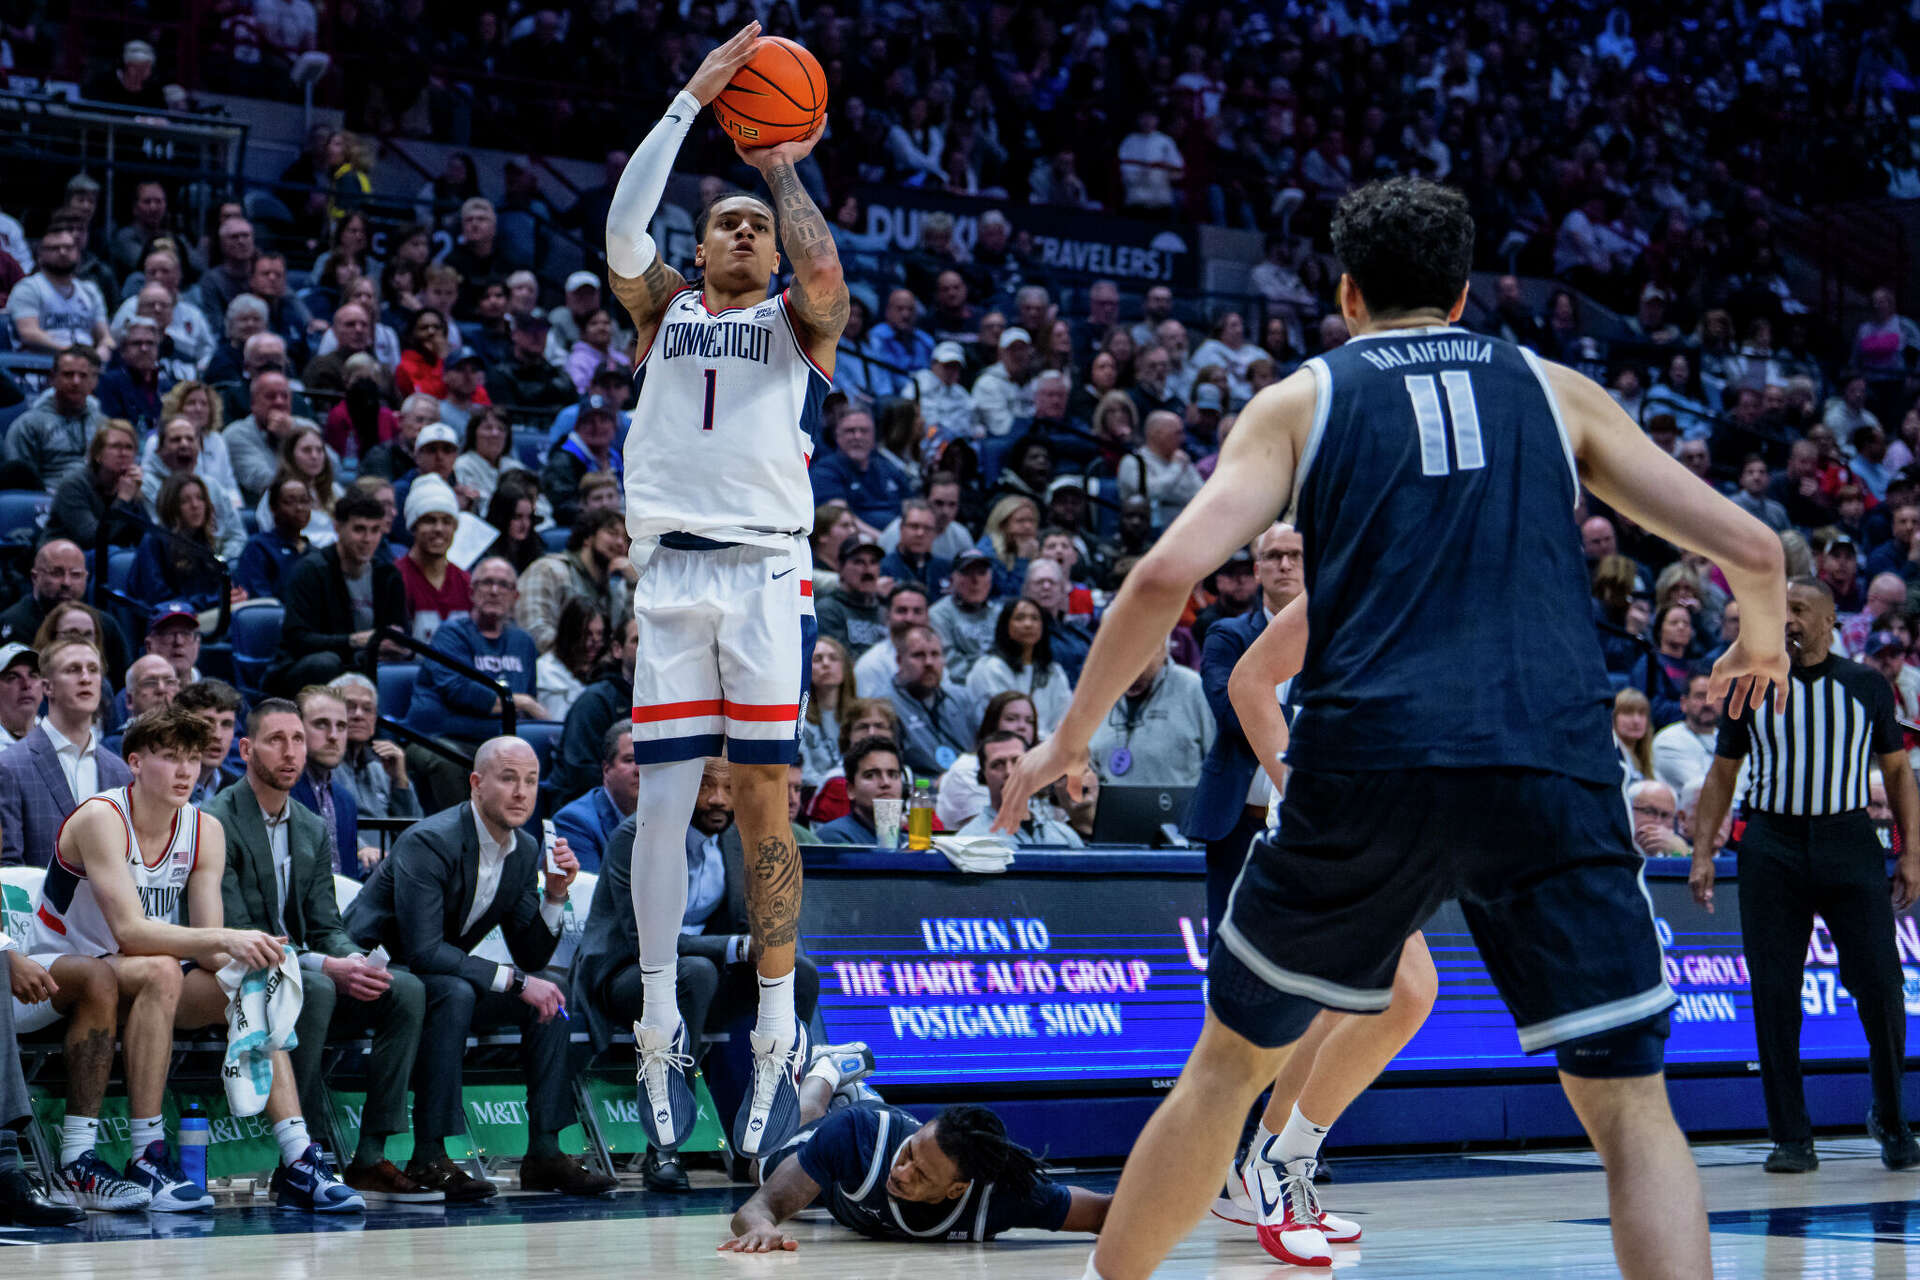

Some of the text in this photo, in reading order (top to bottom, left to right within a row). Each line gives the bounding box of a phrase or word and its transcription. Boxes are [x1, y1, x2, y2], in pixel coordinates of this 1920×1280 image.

[663, 321, 773, 365] CONNECTICUT
[1360, 340, 1493, 371] HALAIFONUA
[702, 368, 717, 431] 1
[1404, 370, 1487, 476] 11
[920, 918, 1050, 952] LISTEN TO
[833, 959, 1151, 997] THE HARTE AUTO GROUP
[888, 1002, 1123, 1040] POSTGAME SHOW
[471, 1100, 524, 1125] M&T
